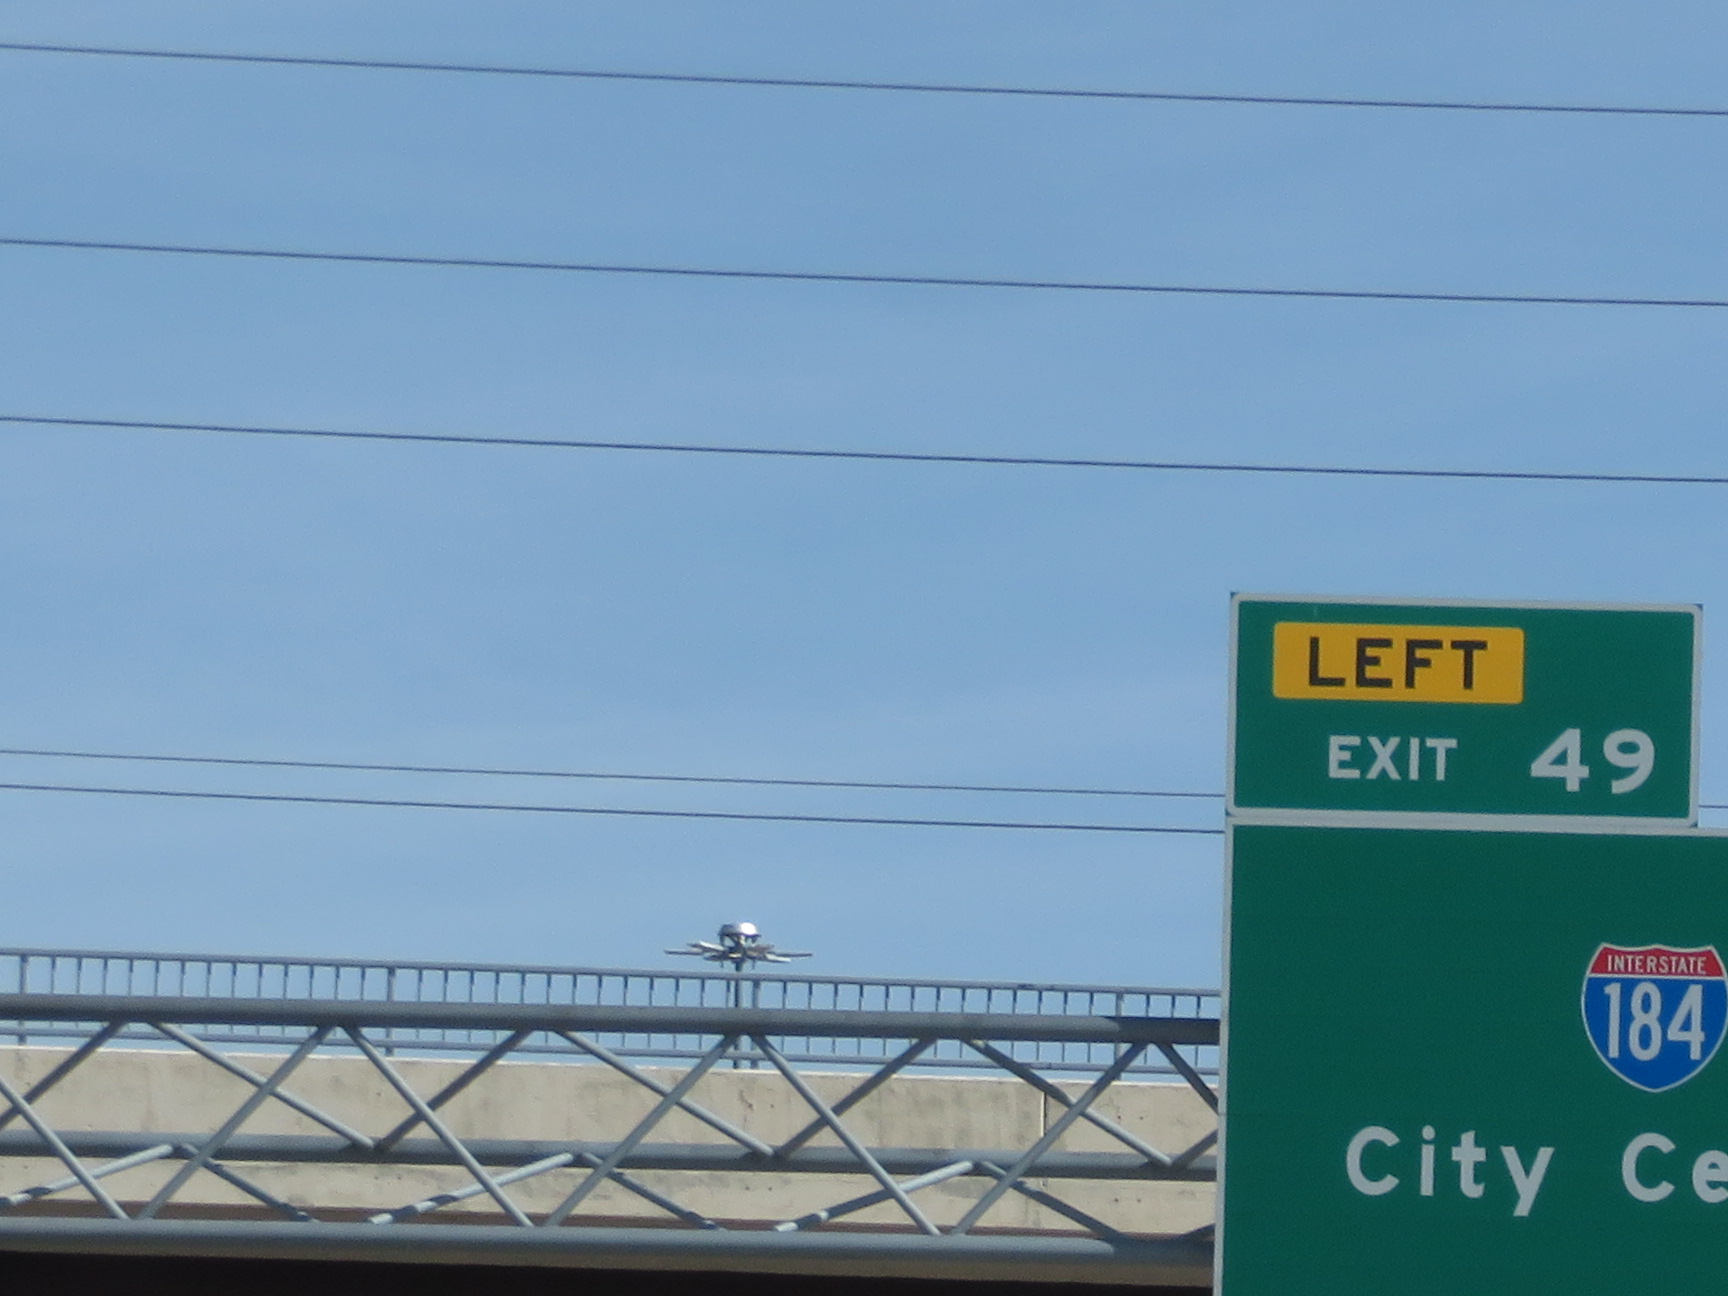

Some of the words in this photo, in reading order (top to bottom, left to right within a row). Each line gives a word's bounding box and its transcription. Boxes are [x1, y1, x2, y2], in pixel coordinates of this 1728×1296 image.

[1308, 636, 1489, 691] LEFT
[1327, 734, 1459, 782] EXIT
[1530, 727, 1656, 794] 49
[1606, 953, 1708, 977] INTERSTATE
[1603, 981, 1706, 1062] 184
[1346, 1125, 1555, 1217] City
